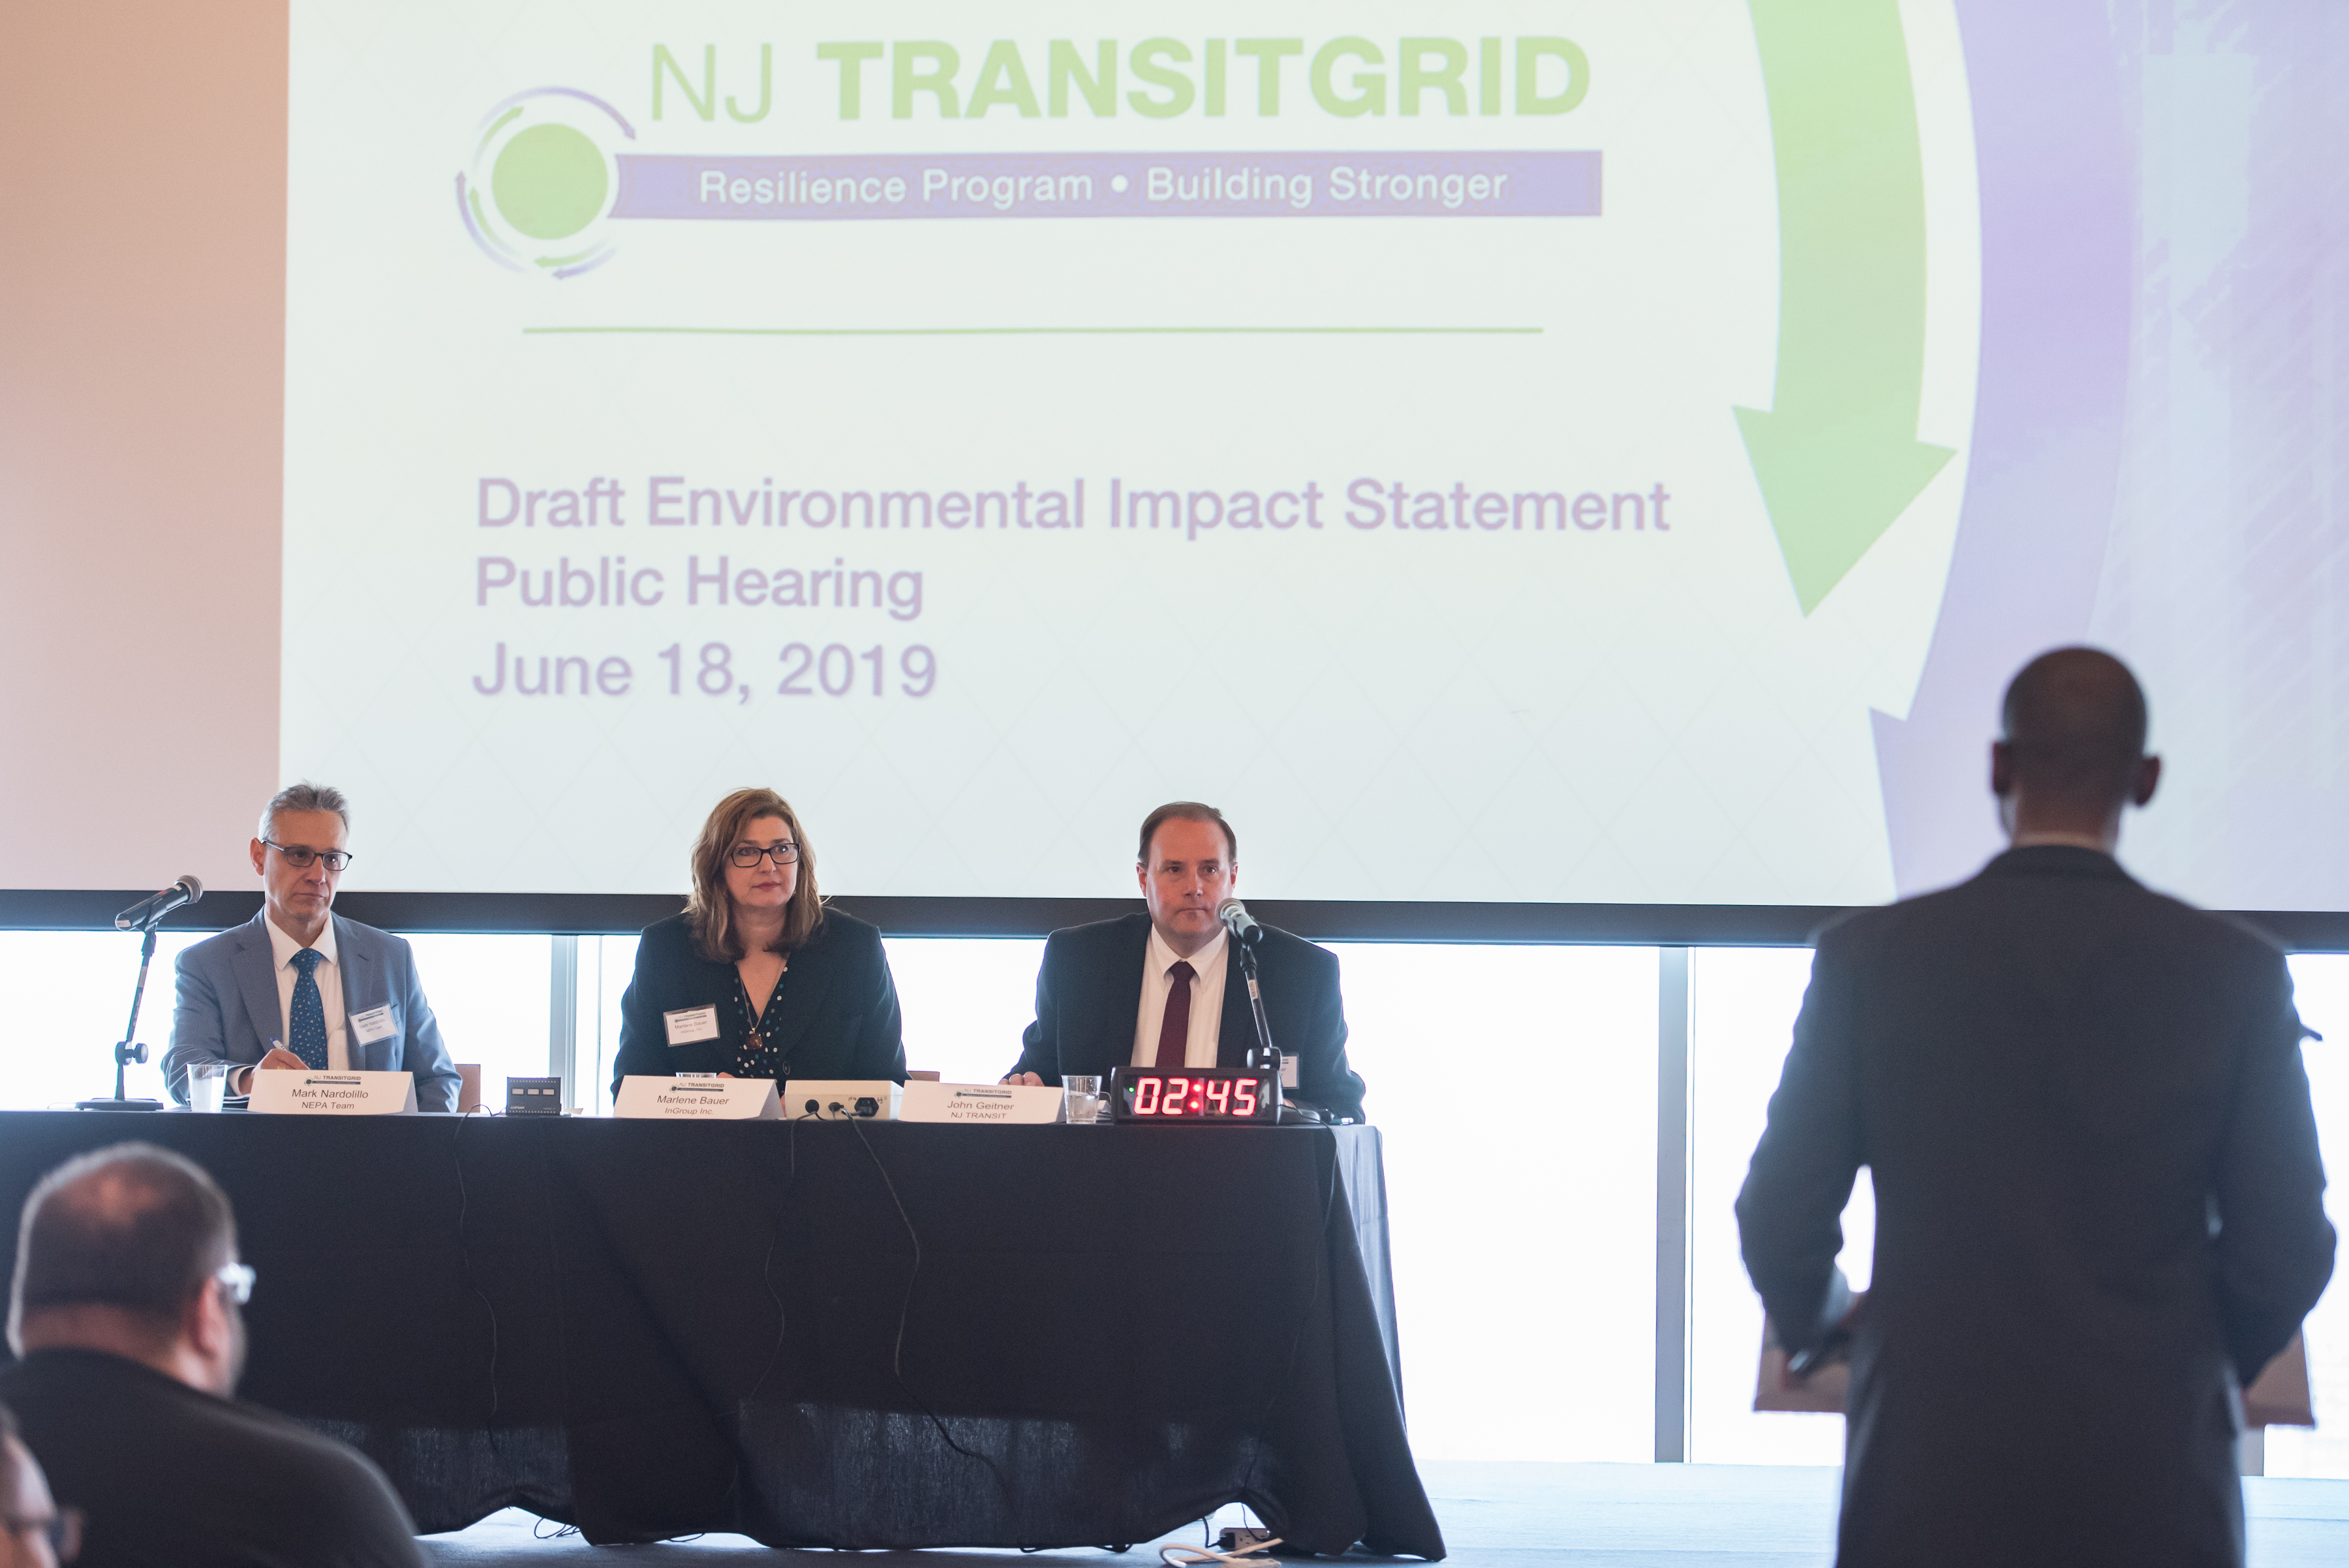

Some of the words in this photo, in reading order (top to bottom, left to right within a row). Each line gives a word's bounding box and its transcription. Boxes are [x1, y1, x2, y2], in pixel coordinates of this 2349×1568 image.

[652, 43, 772, 123] NJ
[817, 37, 1589, 119] TRANSITGRID
[701, 171, 906, 204] Resilience
[923, 169, 1092, 209] Program
[1148, 168, 1312, 208] Building
[1330, 166, 1507, 208] Stronger
[478, 477, 625, 527] Draft
[648, 476, 1084, 529] Environmental
[1111, 478, 1324, 541] Impact
[1345, 478, 1670, 530] Statement
[477, 556, 664, 607] Public
[688, 555, 923, 621] Hearing
[472, 642, 633, 697] June
[658, 642, 750, 705] 18,
[778, 642, 936, 698] 2019
[292, 1089, 317, 1098] Mark
[320, 1090, 369, 1098] Nardolillo
[657, 1096, 697, 1104] Marlene
[699, 1096, 729, 1105] Bauer
[665, 1107, 698, 1116] InGroup
[947, 1101, 972, 1109] John
[976, 1101, 1015, 1110] Geitner
[1134, 1077, 1258, 1116] 02:45
